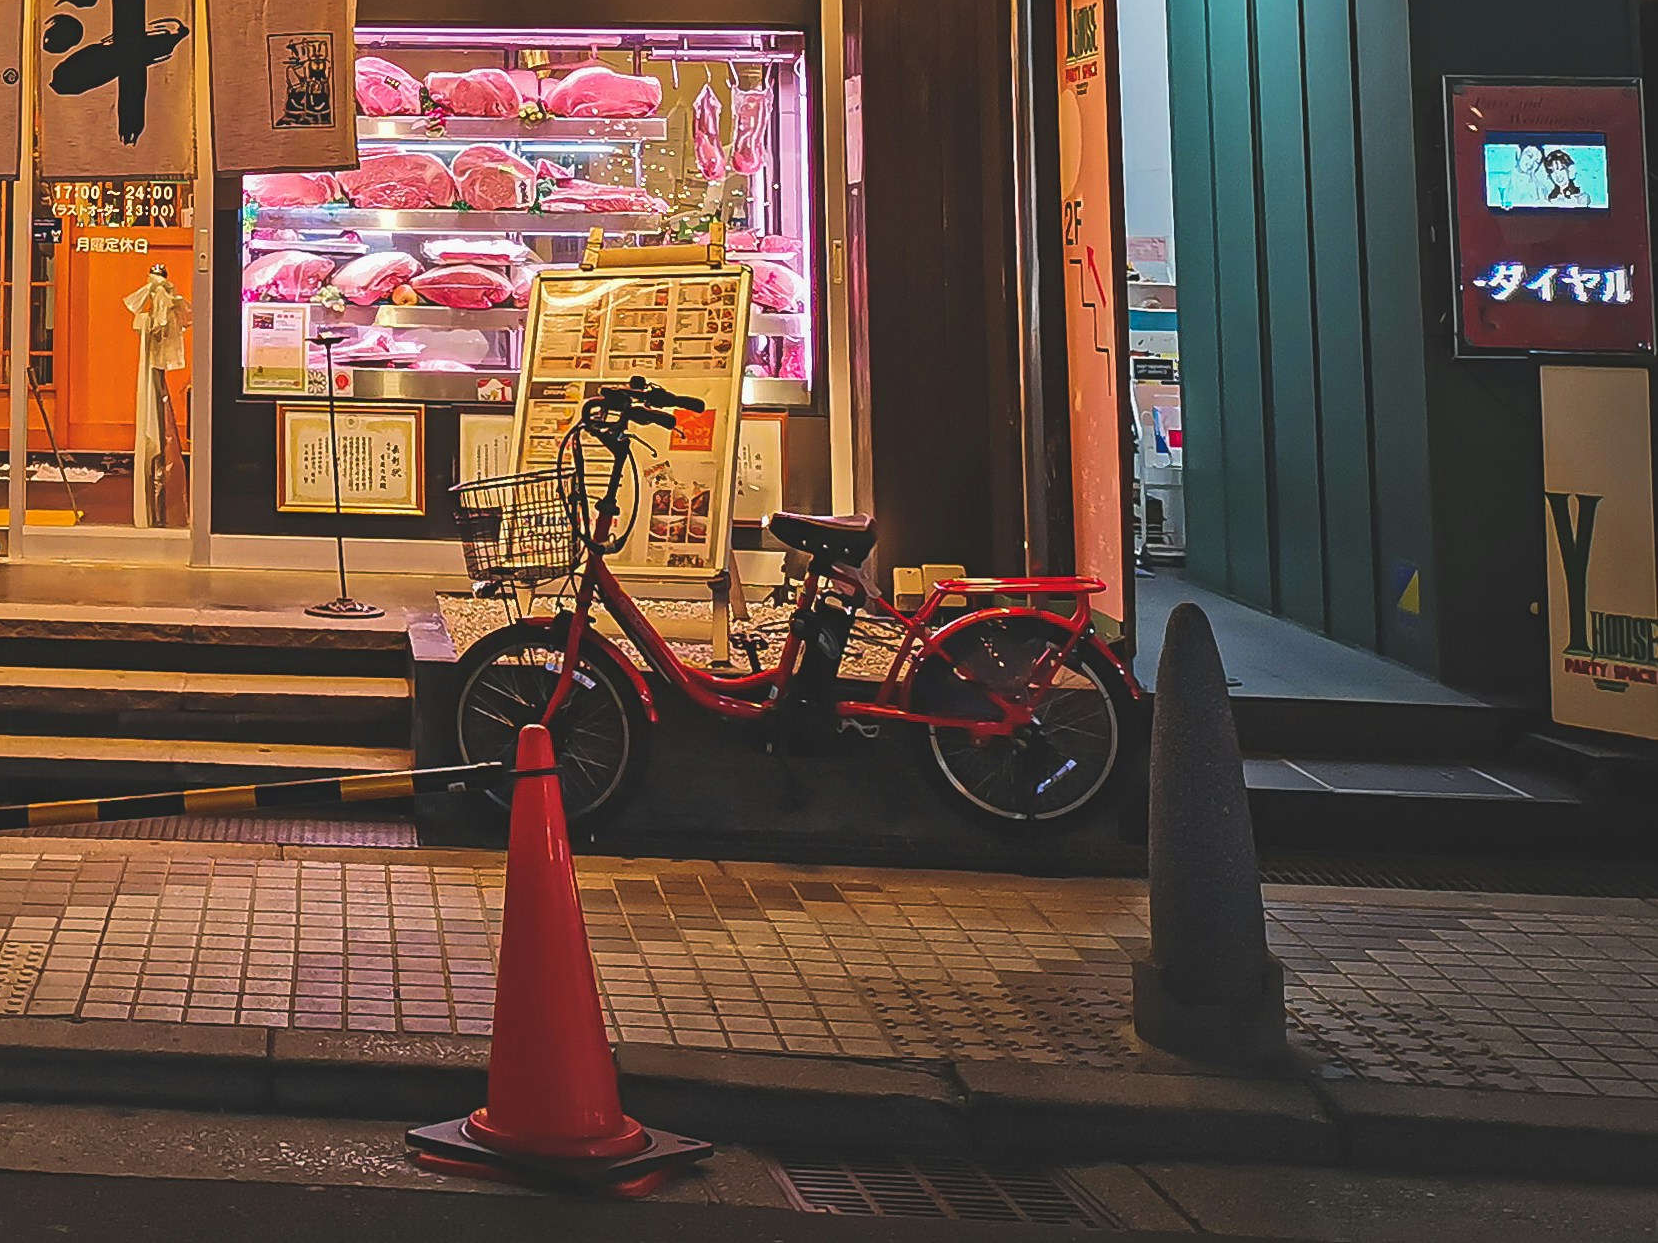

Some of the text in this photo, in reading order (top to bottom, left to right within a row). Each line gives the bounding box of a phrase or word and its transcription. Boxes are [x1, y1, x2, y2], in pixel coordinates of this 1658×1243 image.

[54, 185, 101, 200] 17:00
[125, 185, 173, 200] 24:00
[1064, 199, 1083, 247] 2F
[75, 236, 149, 254] 月曜定休日
[1544, 491, 1605, 656] Y
